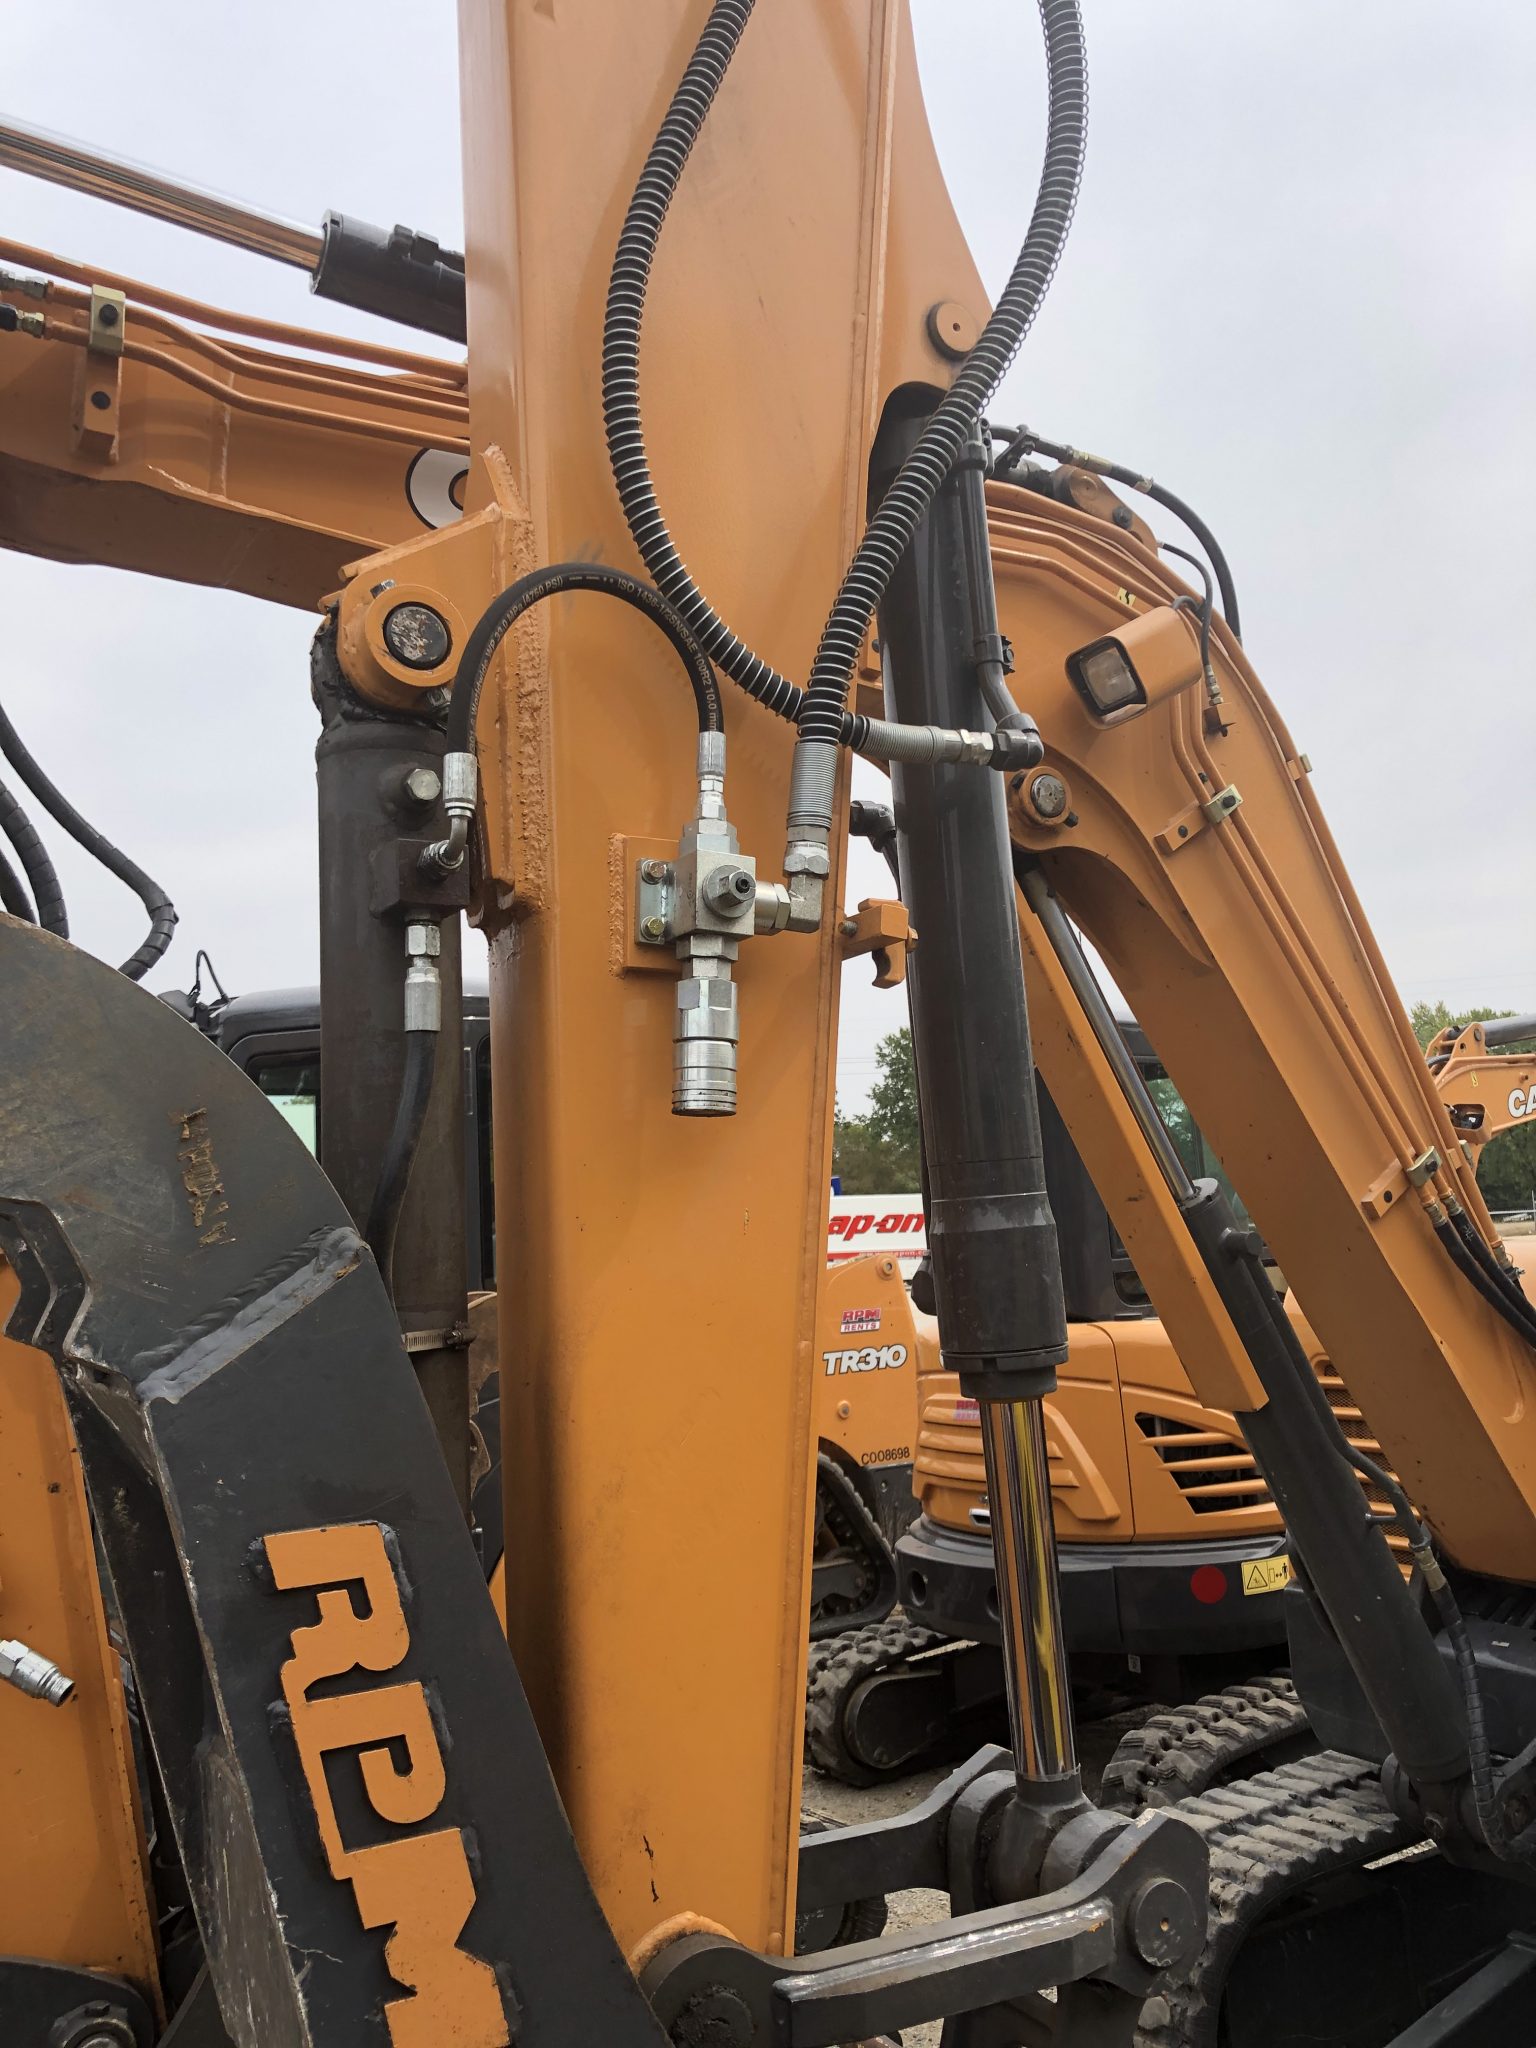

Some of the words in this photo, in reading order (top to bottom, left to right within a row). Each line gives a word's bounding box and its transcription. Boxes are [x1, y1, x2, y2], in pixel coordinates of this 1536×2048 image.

[618, 577, 635, 593] ISO
[694, 653, 712, 686] 100R2
[709, 712, 718, 731] mm
[842, 1309, 881, 1322] RPM
[843, 1322, 877, 1332] RENTS
[822, 1344, 907, 1376] TR310
[263, 1520, 513, 2048] RPM
